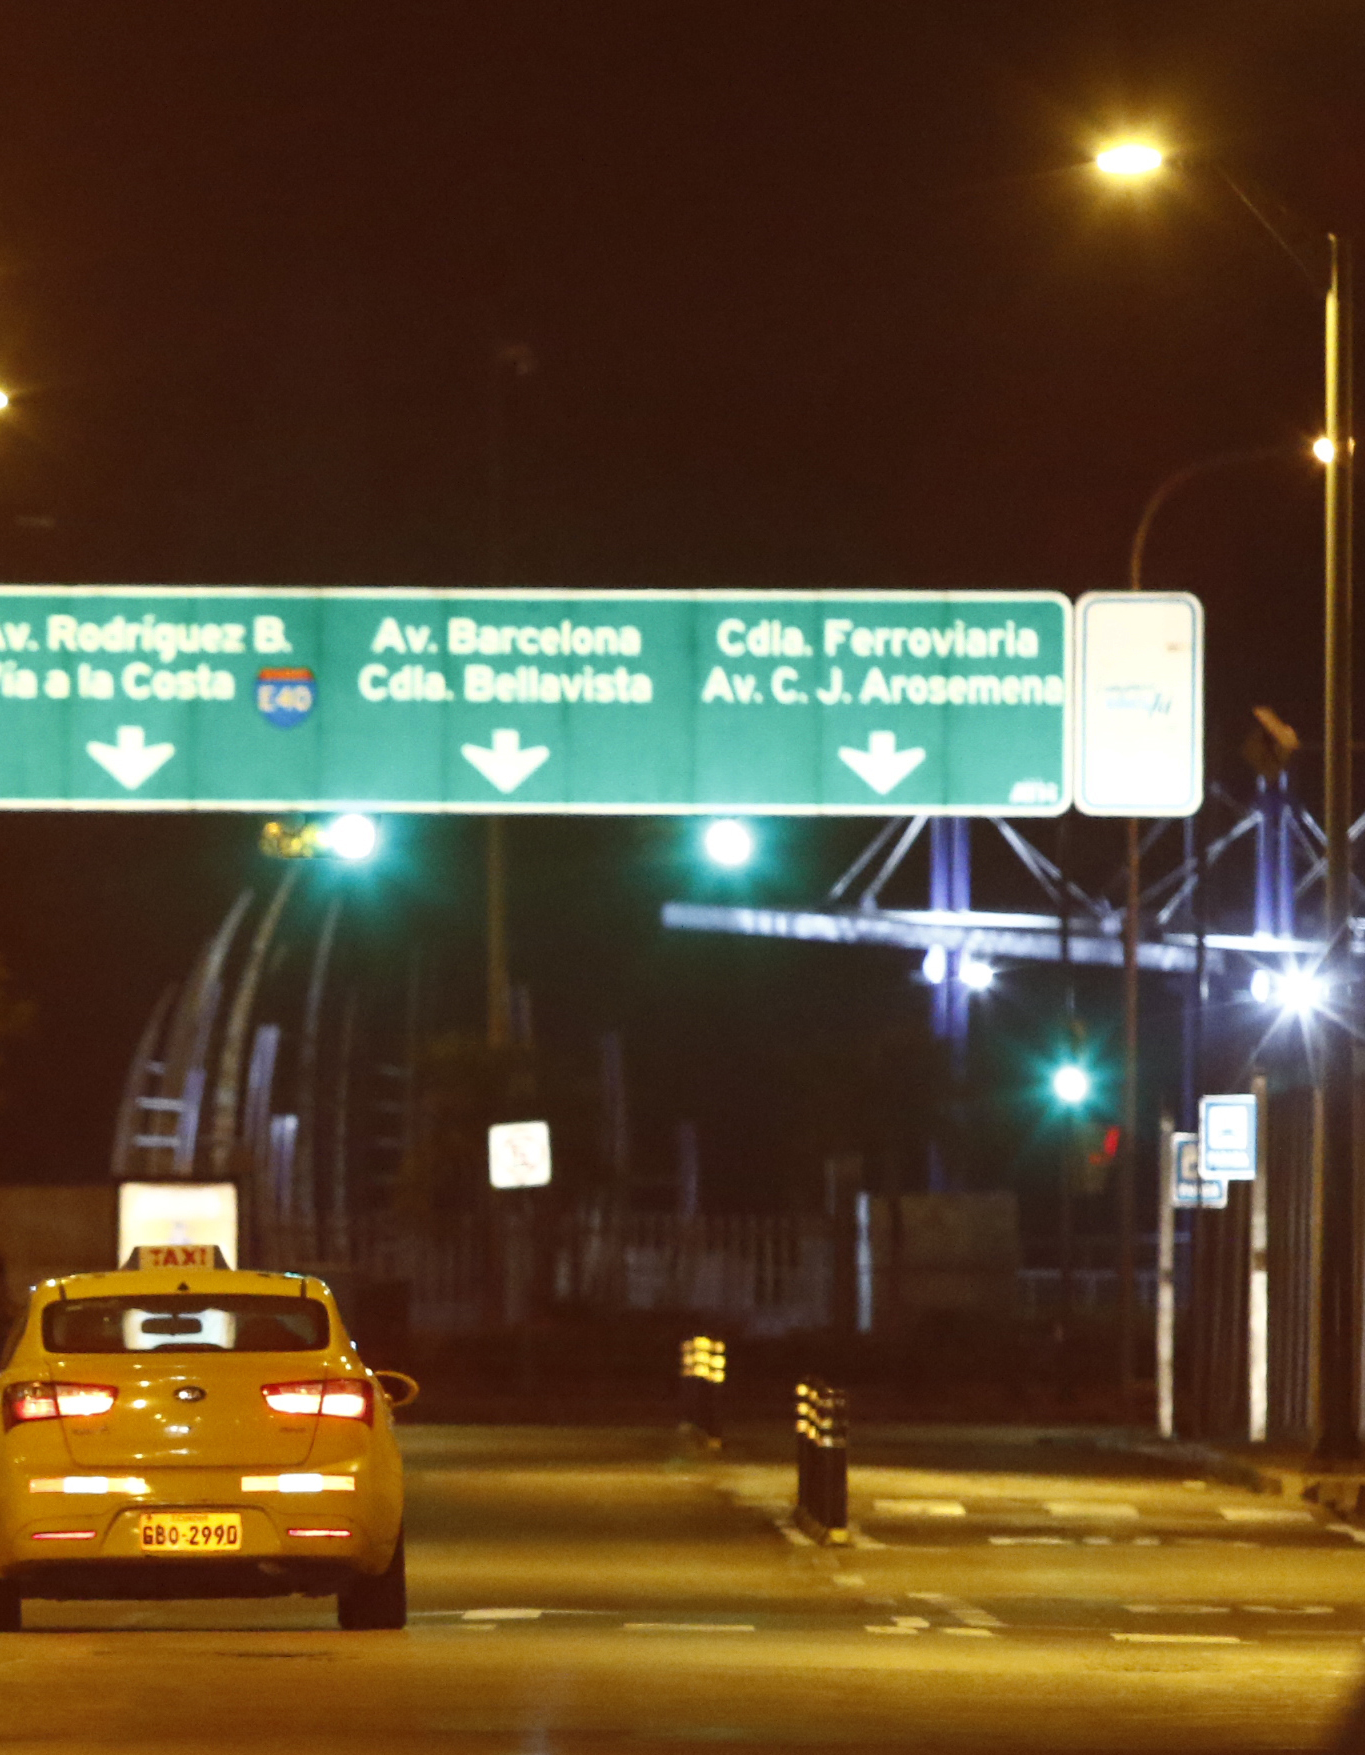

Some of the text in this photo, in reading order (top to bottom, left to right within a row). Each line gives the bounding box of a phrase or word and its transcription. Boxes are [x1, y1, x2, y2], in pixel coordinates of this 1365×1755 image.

[253, 614, 293, 653] B.
[371, 616, 642, 657] Av. Barcelona
[716, 618, 1039, 658] Cdla. Ferroviaria
[44, 669, 70, 699] a
[78, 662, 115, 700] la
[121, 661, 235, 700] Costa
[358, 663, 653, 703] Cdla. Bellavista
[701, 665, 763, 704] Av.
[771, 665, 809, 704] C.
[816, 665, 853, 705] J.
[858, 666, 1064, 705] Arosemena
[149, 1247, 206, 1267] TAXI
